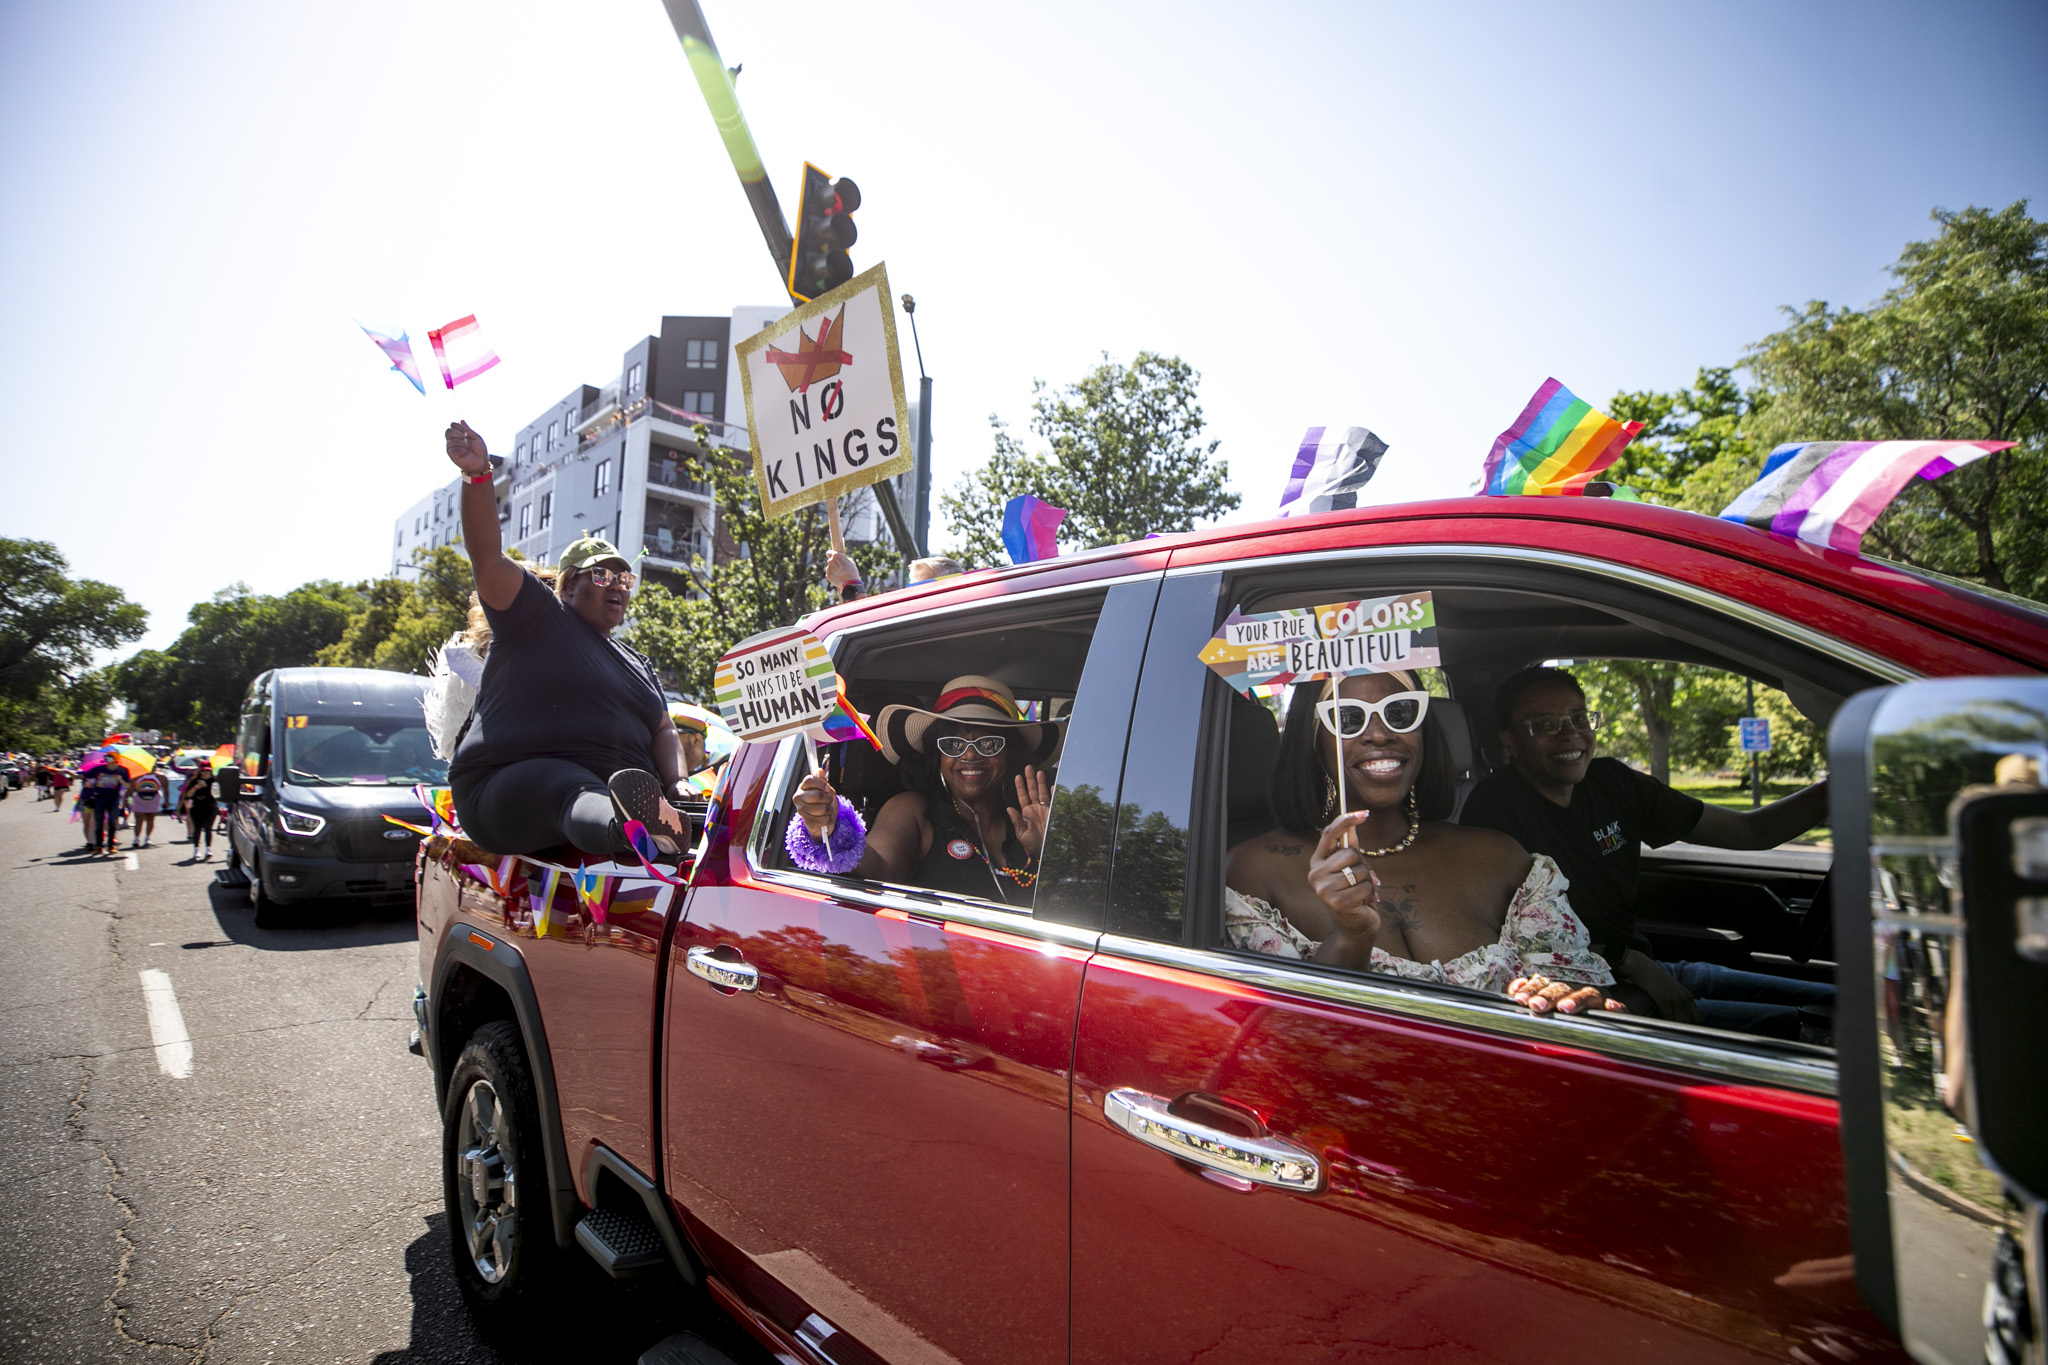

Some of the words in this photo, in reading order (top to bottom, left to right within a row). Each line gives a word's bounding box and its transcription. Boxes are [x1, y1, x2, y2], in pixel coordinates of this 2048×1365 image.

[790, 381, 844, 435] NO
[766, 417, 898, 498] KINGS
[1236, 621, 1269, 644] YOUR
[1273, 618, 1306, 640] TRUE
[1319, 599, 1425, 637] COLORS
[736, 659, 755, 680] SO
[760, 646, 799, 673] MANY
[1246, 651, 1280, 673] ARE
[1291, 632, 1406, 674] BEAUTIFUL
[746, 677, 773, 700] WAYS
[776, 674, 788, 693] TO
[791, 669, 803, 687] BE
[739, 685, 821, 730] HUMAN
